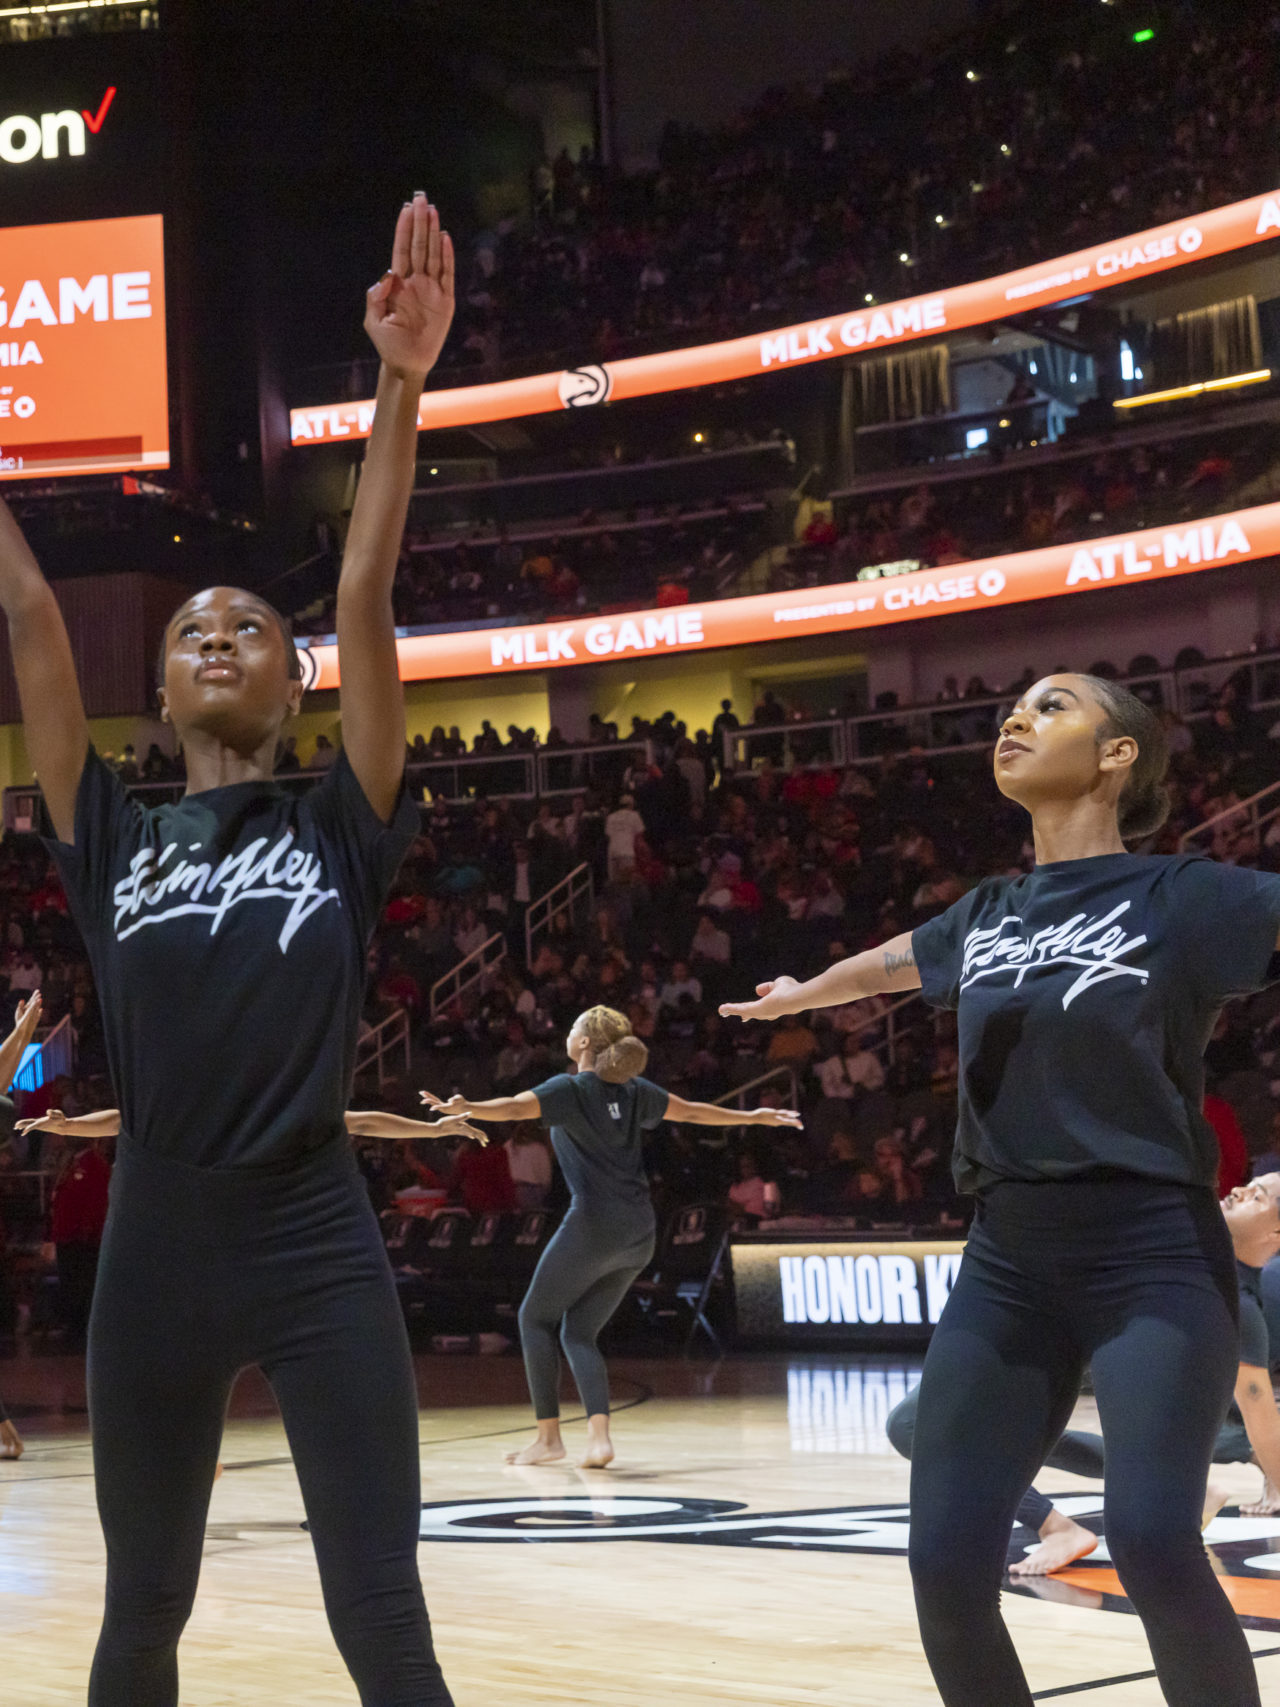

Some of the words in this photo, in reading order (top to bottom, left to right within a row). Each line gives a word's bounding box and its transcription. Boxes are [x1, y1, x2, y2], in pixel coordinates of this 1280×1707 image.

[1096, 235, 1177, 277] CHASE
[760, 324, 834, 367] MLK
[840, 298, 946, 347] GAME
[883, 575, 976, 610] CHASE
[491, 631, 575, 666] MLK
[585, 611, 704, 655] GAME
[779, 1254, 922, 1324] HONOR
